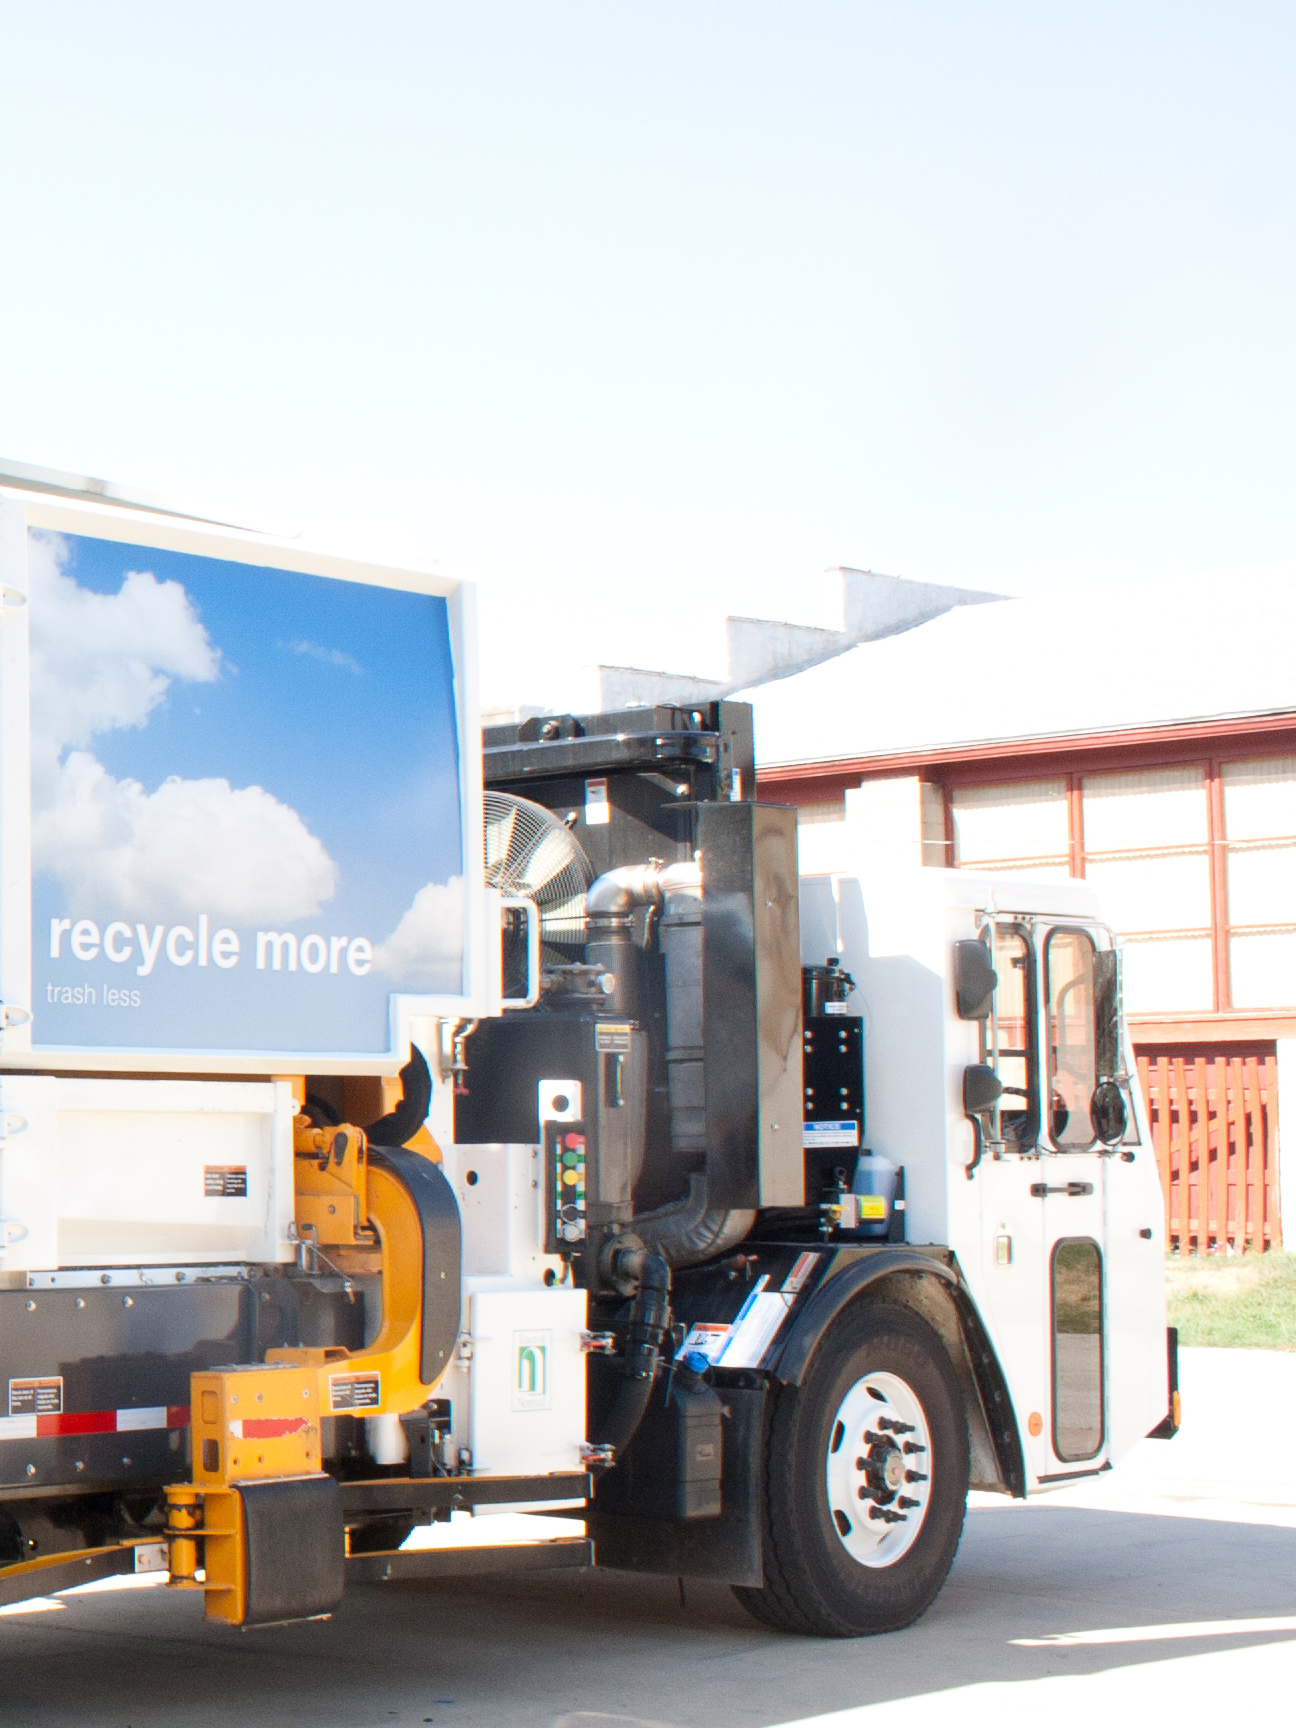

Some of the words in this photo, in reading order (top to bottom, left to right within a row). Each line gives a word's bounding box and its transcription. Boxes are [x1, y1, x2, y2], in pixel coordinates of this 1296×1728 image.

[49, 914, 240, 977] recycle
[256, 931, 373, 976] more
[46, 982, 96, 1005] trash
[103, 984, 142, 1007] less
